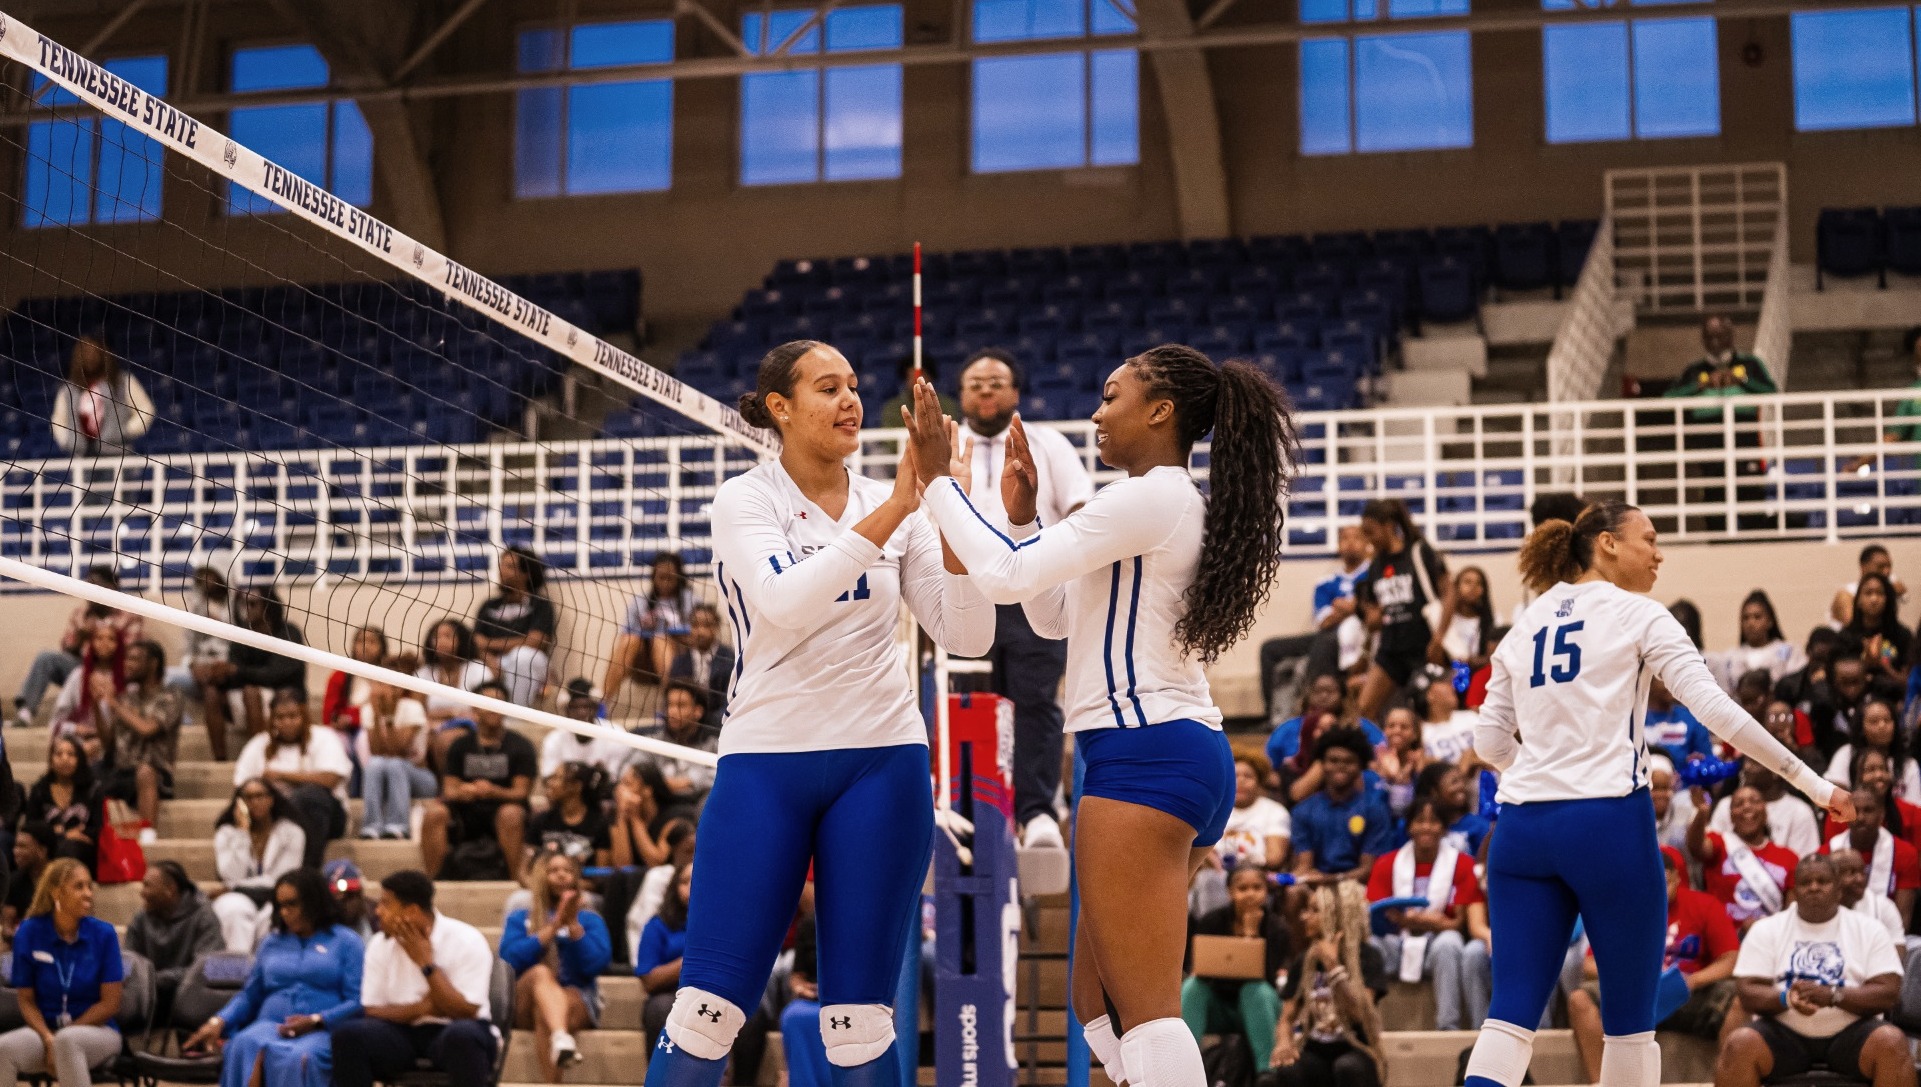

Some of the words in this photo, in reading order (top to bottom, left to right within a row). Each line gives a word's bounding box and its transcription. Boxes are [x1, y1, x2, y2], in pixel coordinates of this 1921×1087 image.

[38, 34, 140, 117] TENNESSEE
[143, 95, 198, 149] STATE
[263, 160, 345, 228] TENNESSEE
[348, 207, 392, 253] STATE
[445, 258, 512, 315] TENNESSEE
[512, 297, 551, 336] STATE
[593, 338, 650, 388] TENNESSEE
[652, 370, 683, 403] STATE
[1530, 620, 1584, 688] 15
[958, 1004, 980, 1060] sports
